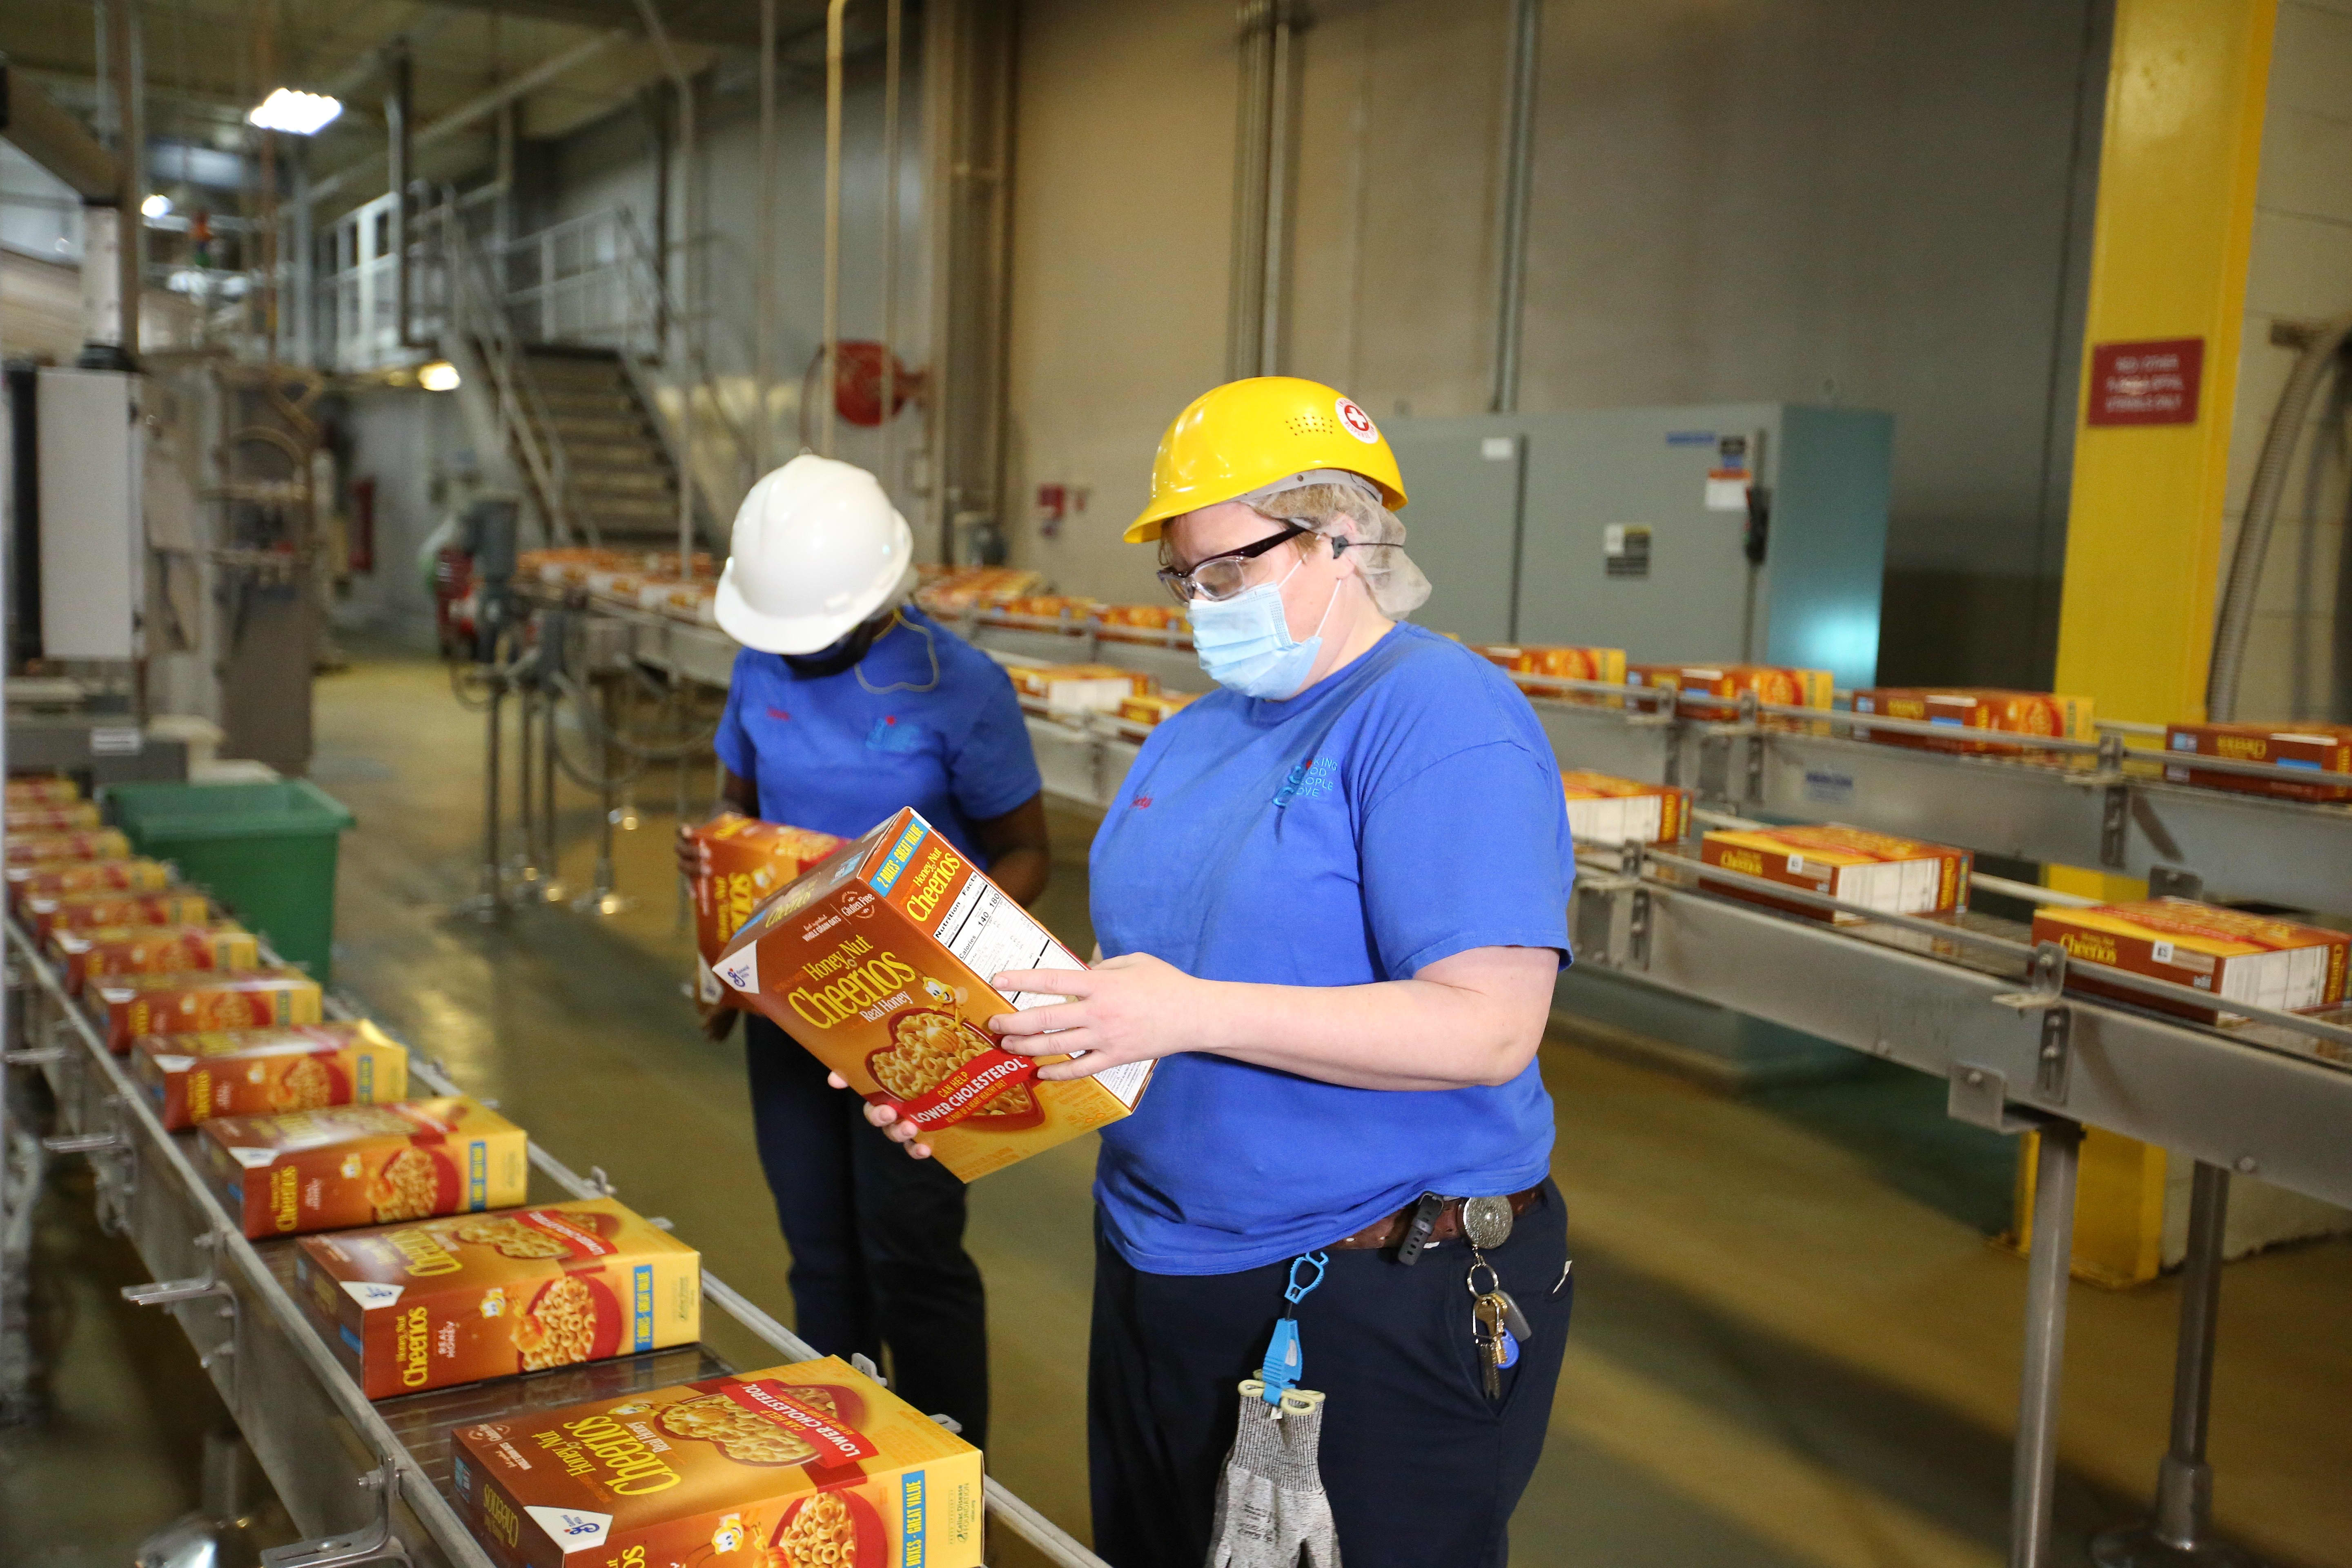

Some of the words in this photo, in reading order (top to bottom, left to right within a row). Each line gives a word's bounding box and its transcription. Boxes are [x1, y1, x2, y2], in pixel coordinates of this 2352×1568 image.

[1310, 767, 1327, 776] OD
[1313, 757, 1338, 771] KING
[1296, 786, 1319, 797] OVE
[908, 823, 924, 846] VALUE
[894, 839, 913, 863] GREAT
[880, 859, 900, 884] BOXES
[913, 862, 937, 887] Honey
[928, 847, 942, 864] Nut
[877, 877, 888, 888] 2
[906, 852, 960, 922] Cheerios
[841, 901, 860, 917] Gluten
[858, 893, 875, 909] Free
[935, 901, 960, 938] Nutrition
[962, 874, 977, 896] Facts
[802, 929, 819, 942] WHOLE
[828, 915, 842, 929] OATS
[959, 935, 976, 959] Calories
[978, 912, 989, 927] 140
[989, 893, 1000, 908] 180
[802, 951, 850, 981] Honey
[838, 934, 874, 959] Nut
[788, 951, 916, 1029] Cheerios
[859, 1004, 885, 1022] Real
[878, 991, 913, 1013] Honey
[910, 1102, 955, 1123] LOWER
[948, 1058, 1029, 1107] CHOLESTEROL
[937, 1085, 955, 1098] CAN
[949, 1071, 969, 1088] HELP
[403, 1306, 428, 1387] Cheerios
[742, 1383, 823, 1428] CHOLESTEROL
[760, 1410, 787, 1422] HELP
[625, 1421, 657, 1446] Honey
[780, 1419, 807, 1431] CAN
[531, 1430, 567, 1449] Nut
[653, 1438, 672, 1453] Real
[816, 1428, 861, 1457] LOWER
[552, 1446, 597, 1477] Honey
[563, 1416, 681, 1495] Cheerios
[906, 1480, 922, 1508] VALUE
[906, 1508, 922, 1534] GREAT
[906, 1539, 922, 1567] BOXES
